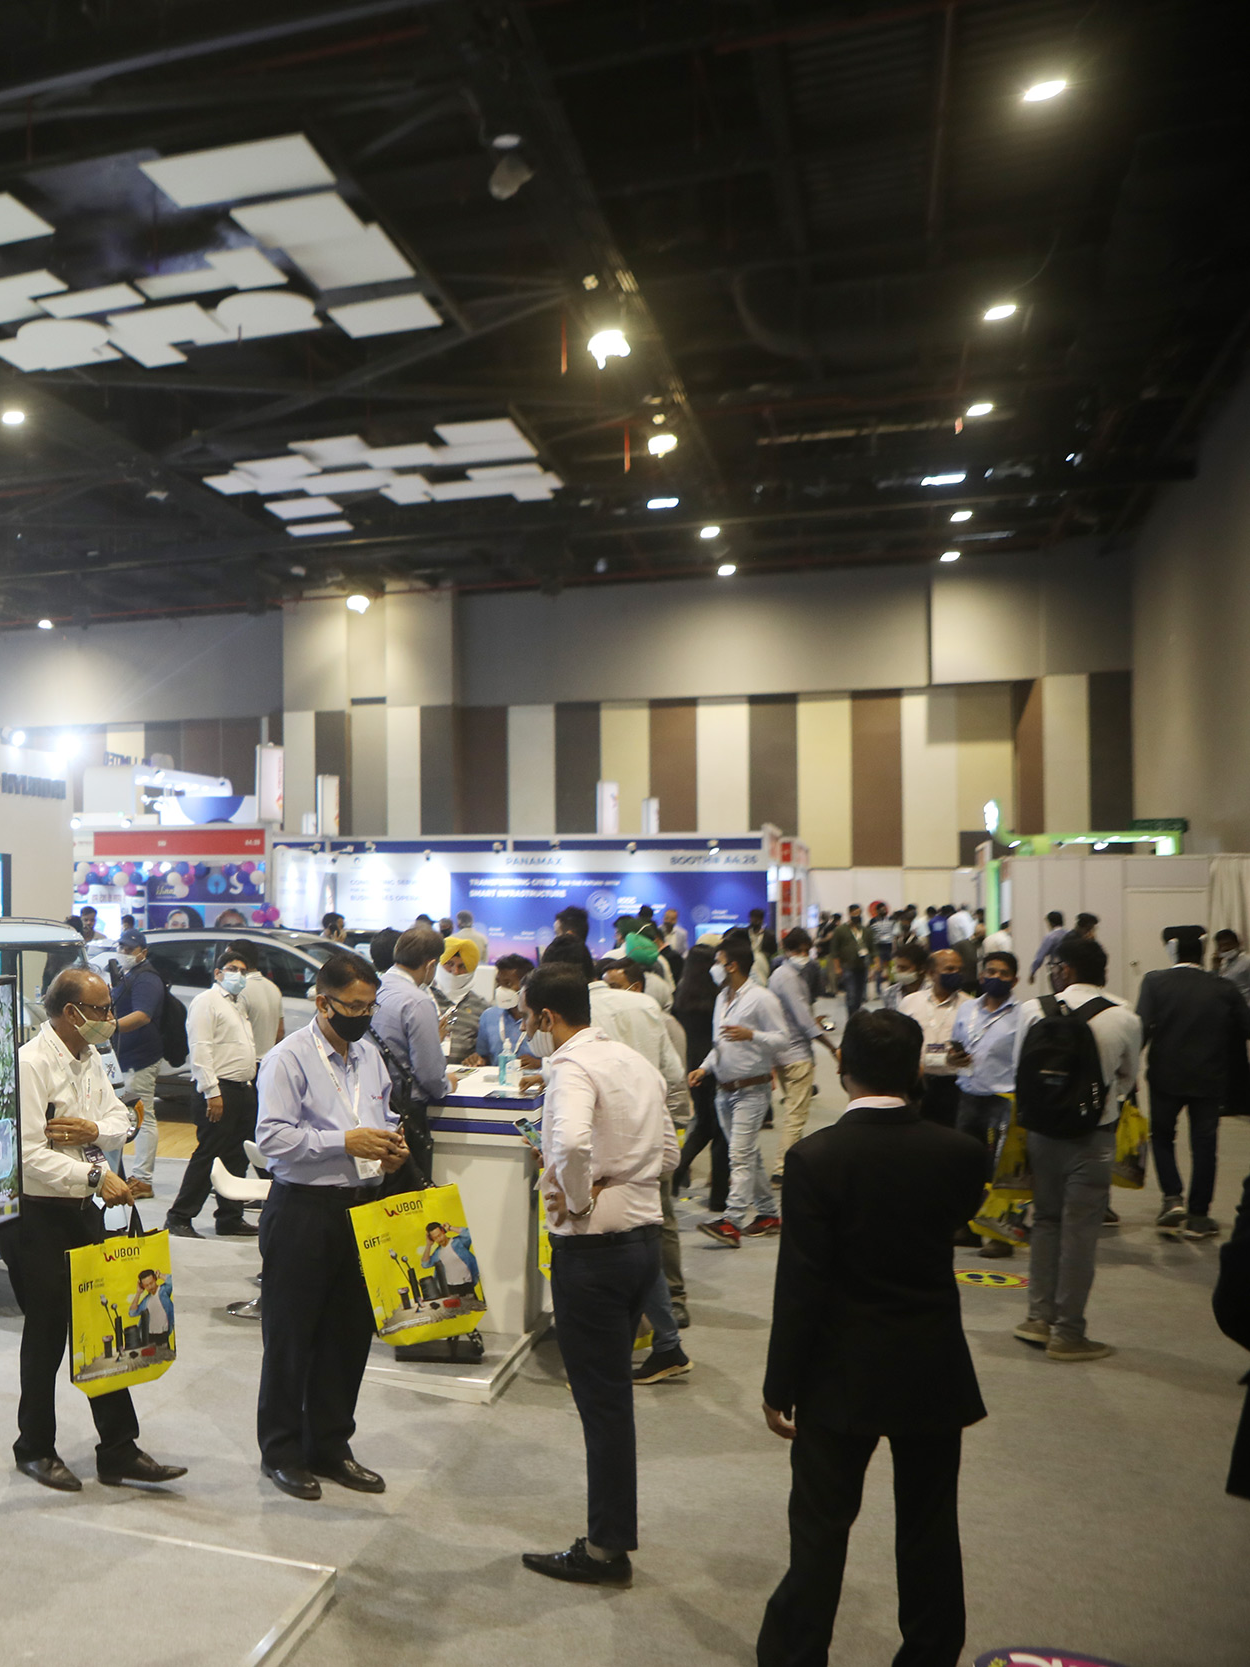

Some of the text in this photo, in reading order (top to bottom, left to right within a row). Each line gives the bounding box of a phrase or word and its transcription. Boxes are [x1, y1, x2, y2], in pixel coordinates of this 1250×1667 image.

[506, 856, 563, 866] PANAMAX
[363, 1236, 381, 1250] GIFT
[78, 1280, 94, 1294] GIFT
